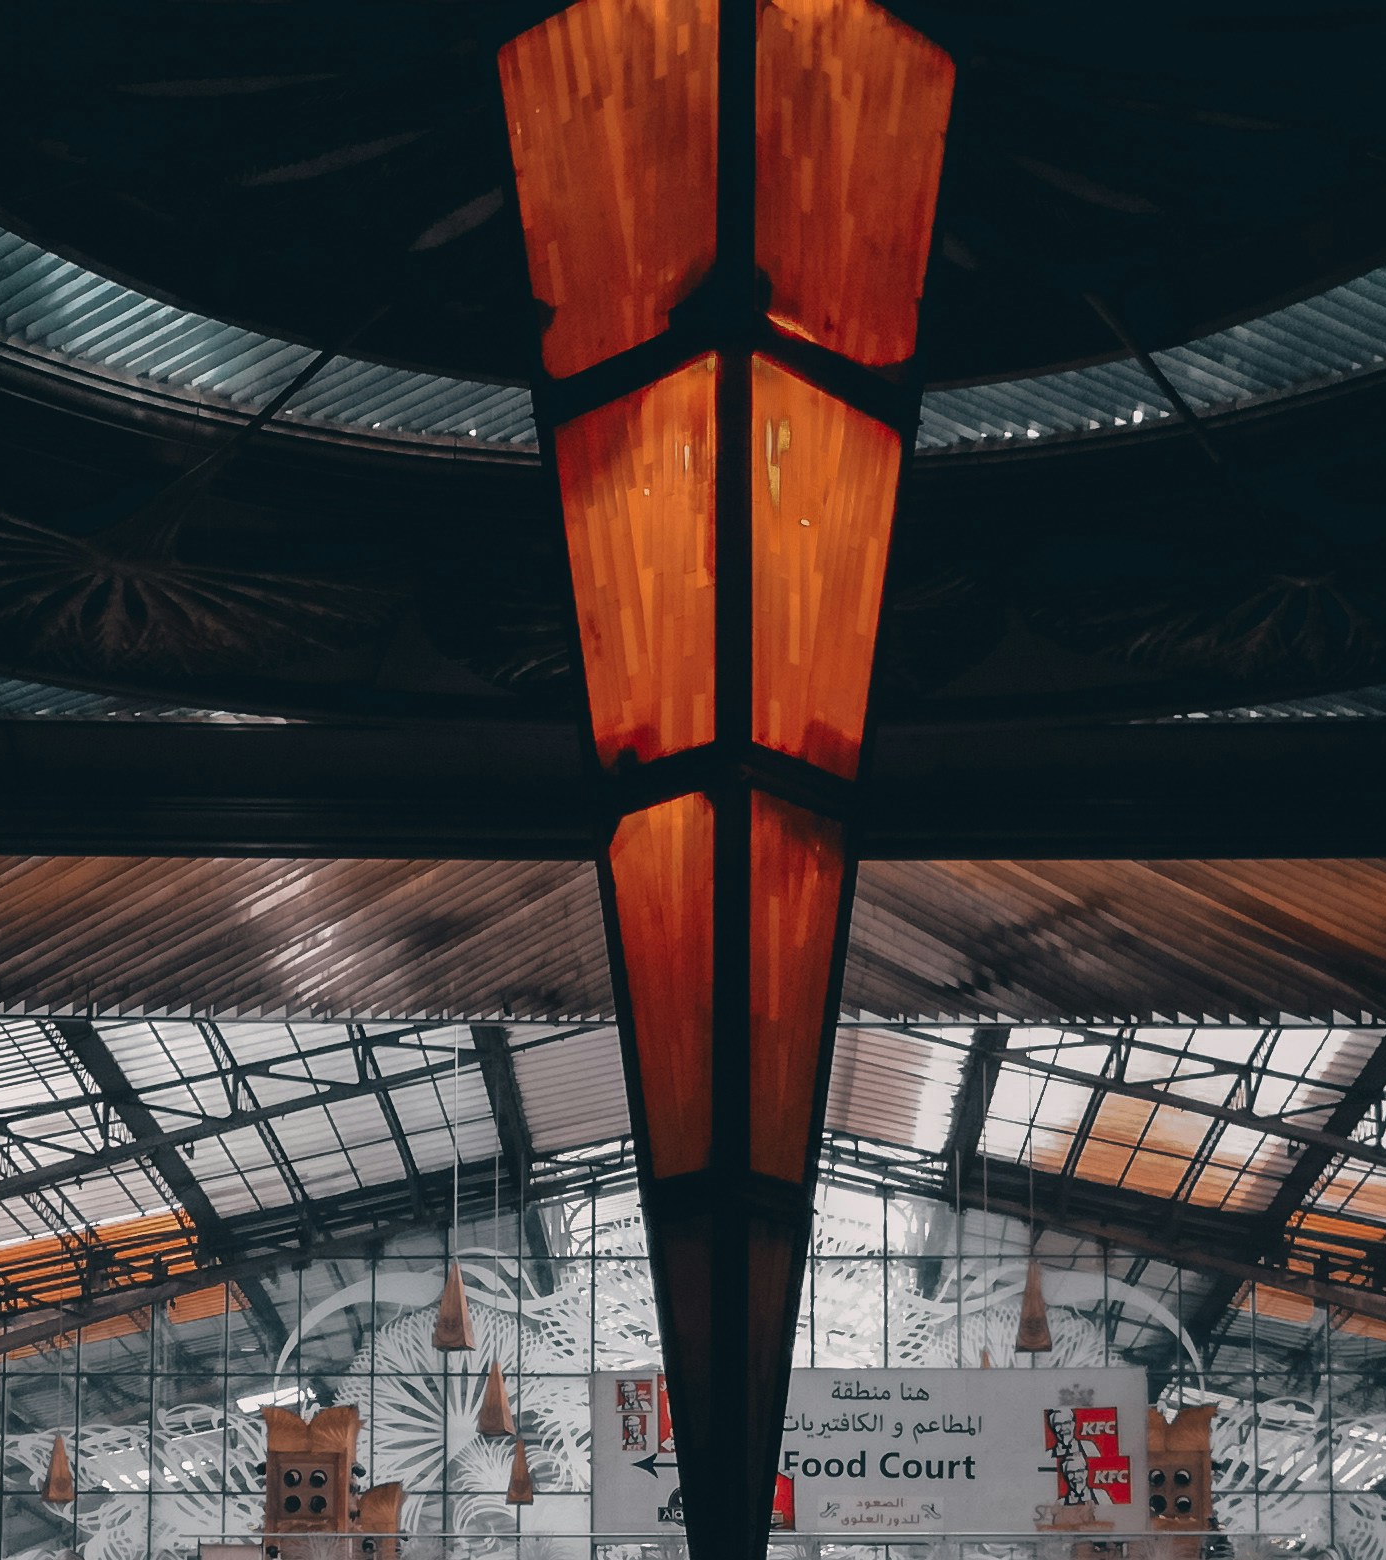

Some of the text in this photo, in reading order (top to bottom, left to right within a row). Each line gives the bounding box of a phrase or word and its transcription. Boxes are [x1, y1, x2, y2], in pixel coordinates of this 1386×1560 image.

[831, 1380, 930, 1402] هنا منطقة
[912, 1414, 982, 1444] المطاعم
[1081, 1420, 1116, 1436] KFC
[783, 1450, 976, 1480] Food Court
[1093, 1470, 1129, 1484] KFC
